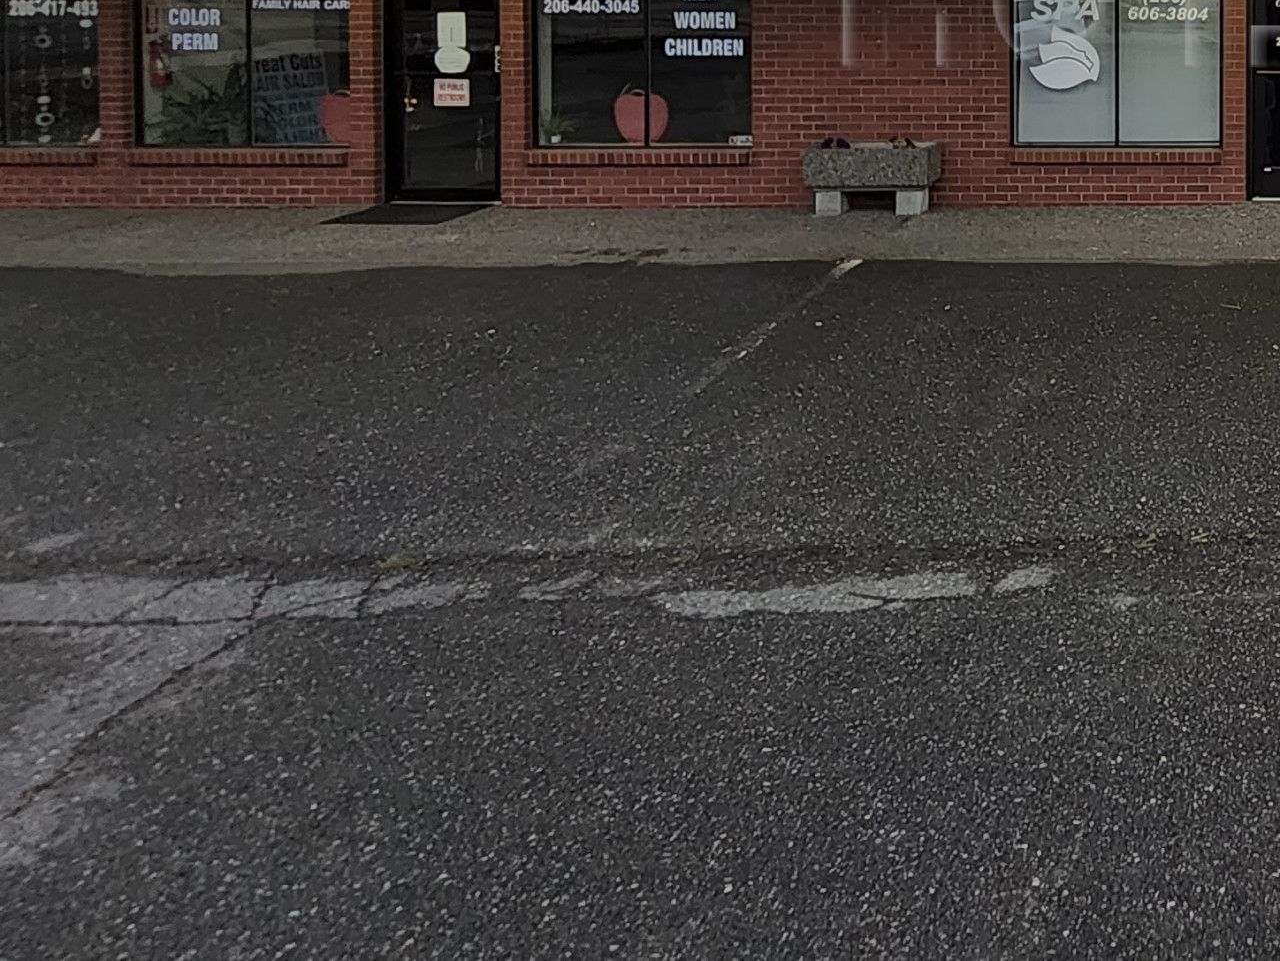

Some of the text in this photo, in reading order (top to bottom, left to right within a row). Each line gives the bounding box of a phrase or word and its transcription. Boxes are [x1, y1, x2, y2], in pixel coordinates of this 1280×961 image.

[252, 0, 291, 10] FAMILY
[293, 0, 320, 10] HAIR
[1127, 6, 1209, 22] 606-3804
[168, 8, 221, 26] COLOR
[673, 11, 736, 30] WOMEN
[172, 33, 218, 50] PERM
[664, 38, 744, 57] CHILDREN
[289, 52, 323, 71] Cuts
